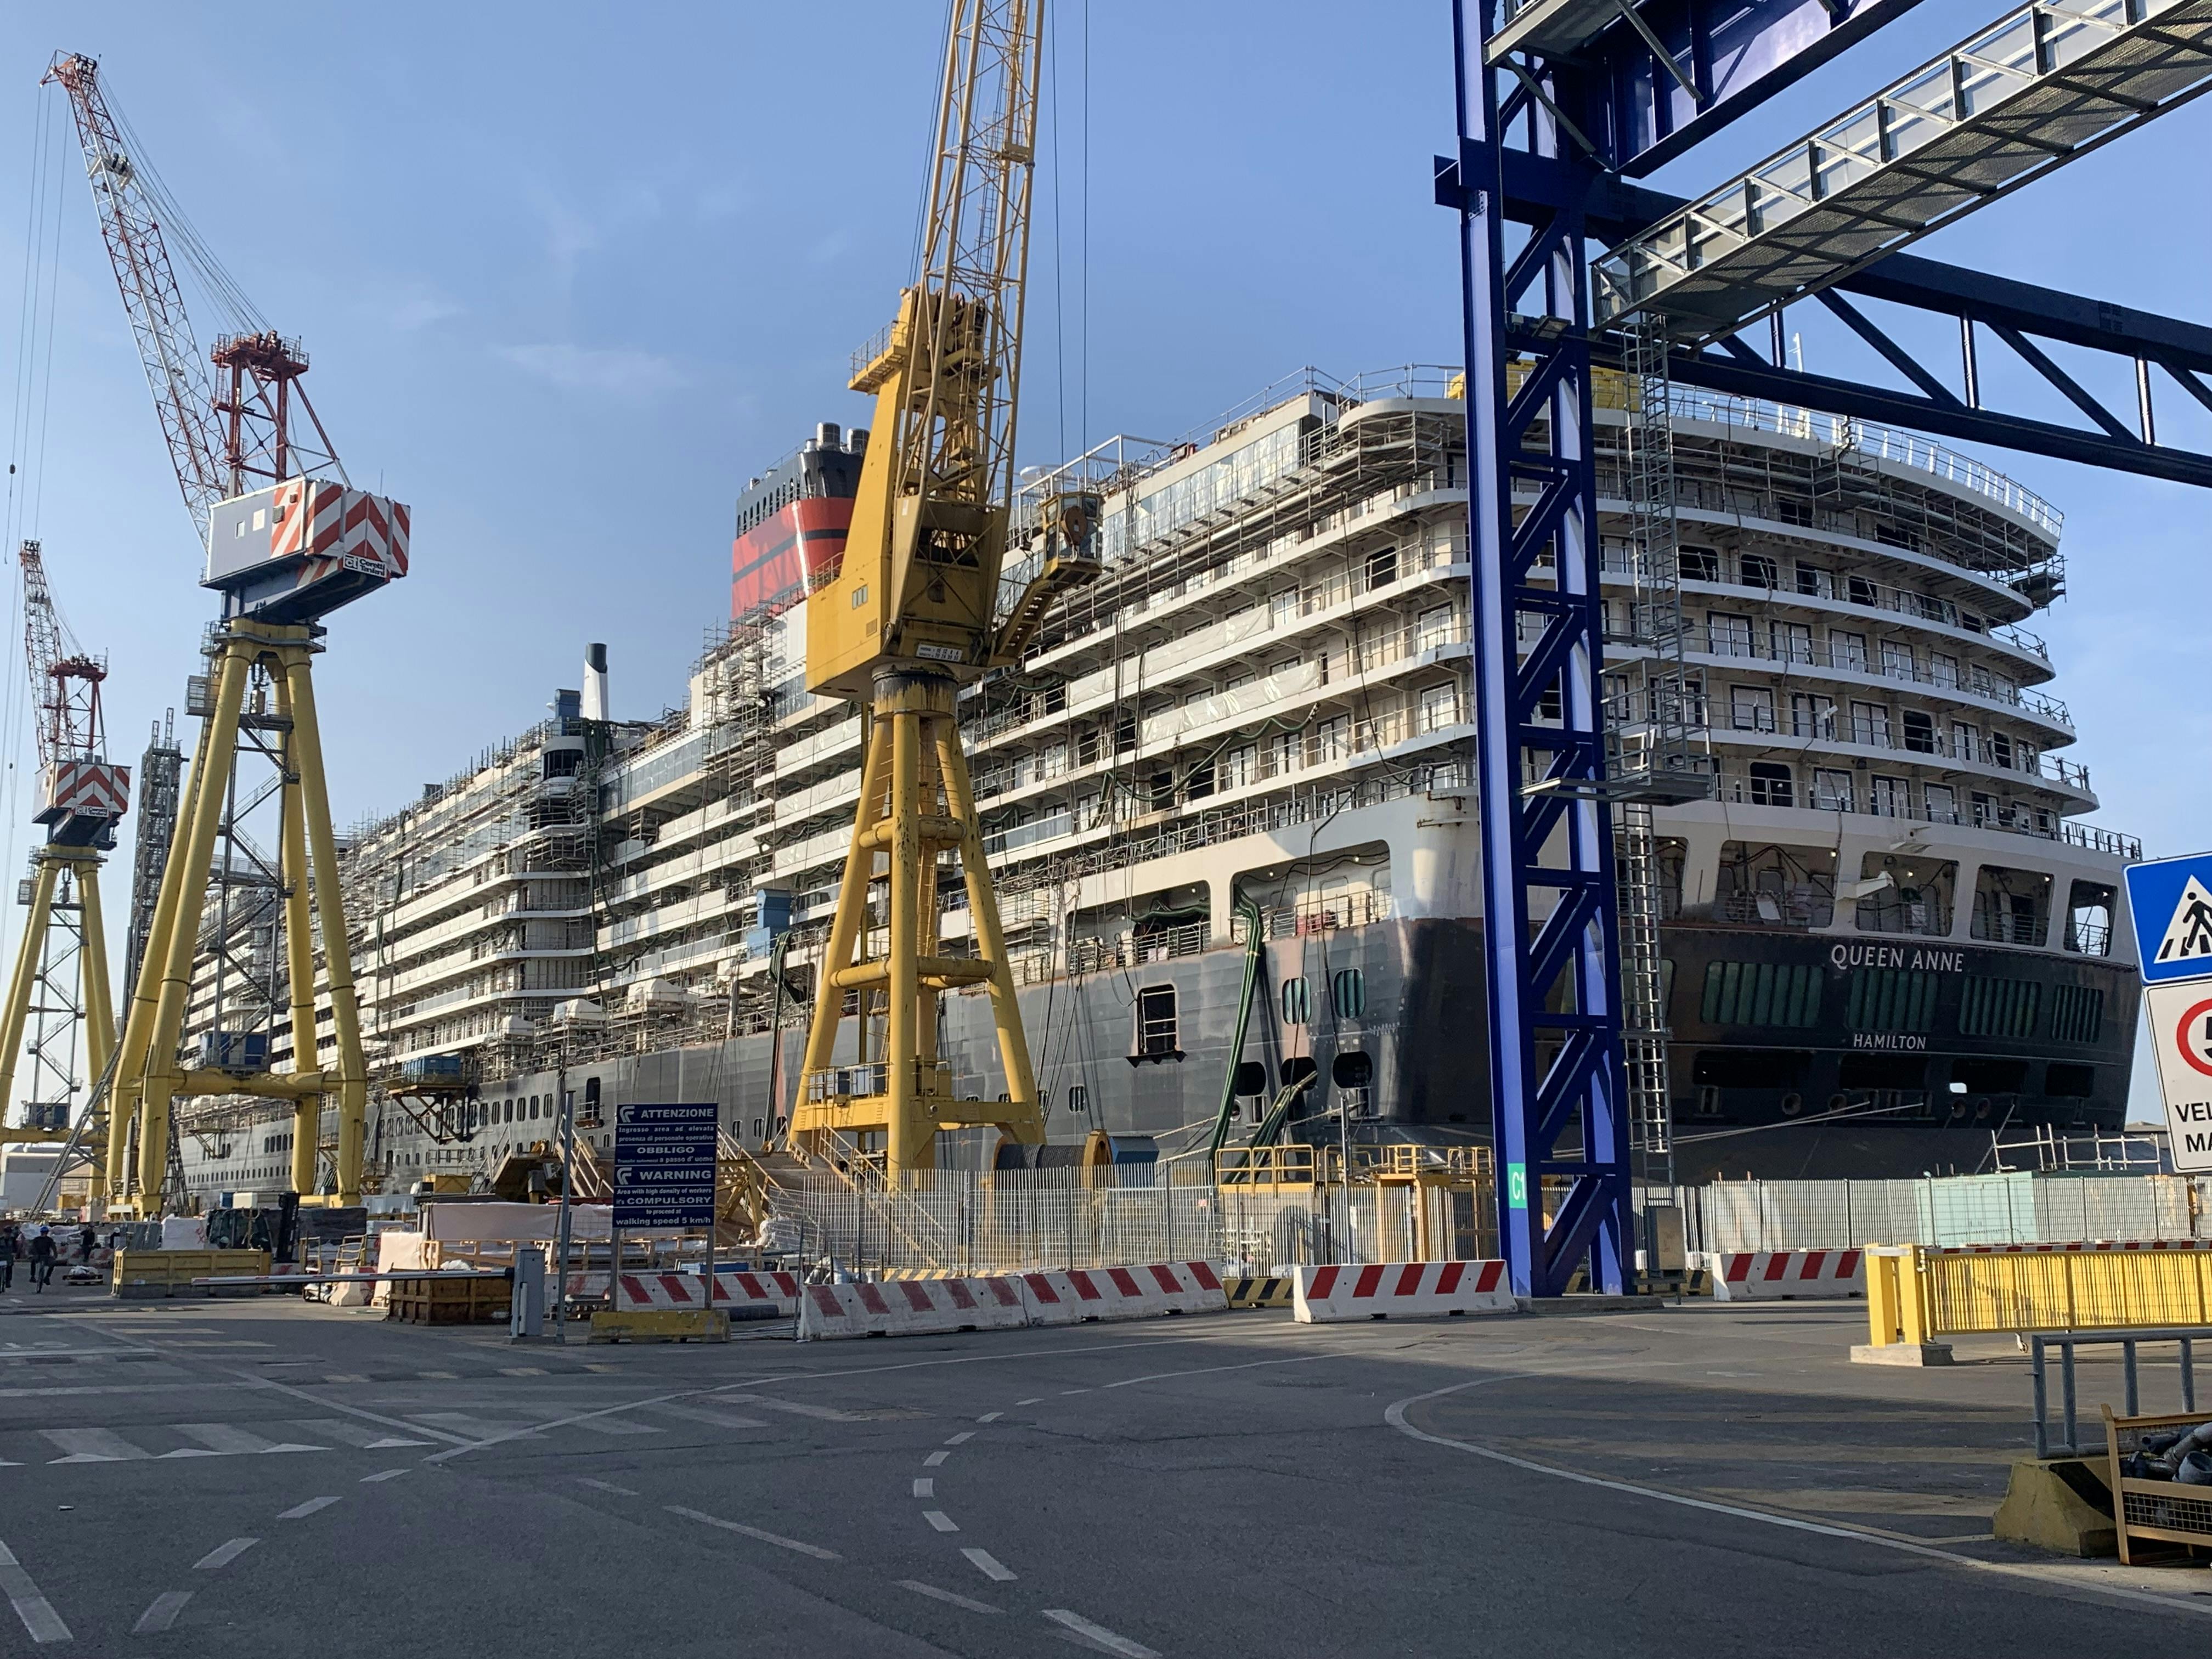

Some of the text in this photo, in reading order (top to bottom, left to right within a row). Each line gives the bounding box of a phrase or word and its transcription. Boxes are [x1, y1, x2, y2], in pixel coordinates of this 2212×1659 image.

[1831, 944, 1964, 972] QUEEN ANNE
[1853, 1034, 1926, 1049] HAMILTON
[641, 1109, 714, 1118] ATTENZIONE
[2186, 1132, 2212, 1153] M
[639, 1170, 712, 1180] WARNING
[1513, 1172, 1525, 1200] C1
